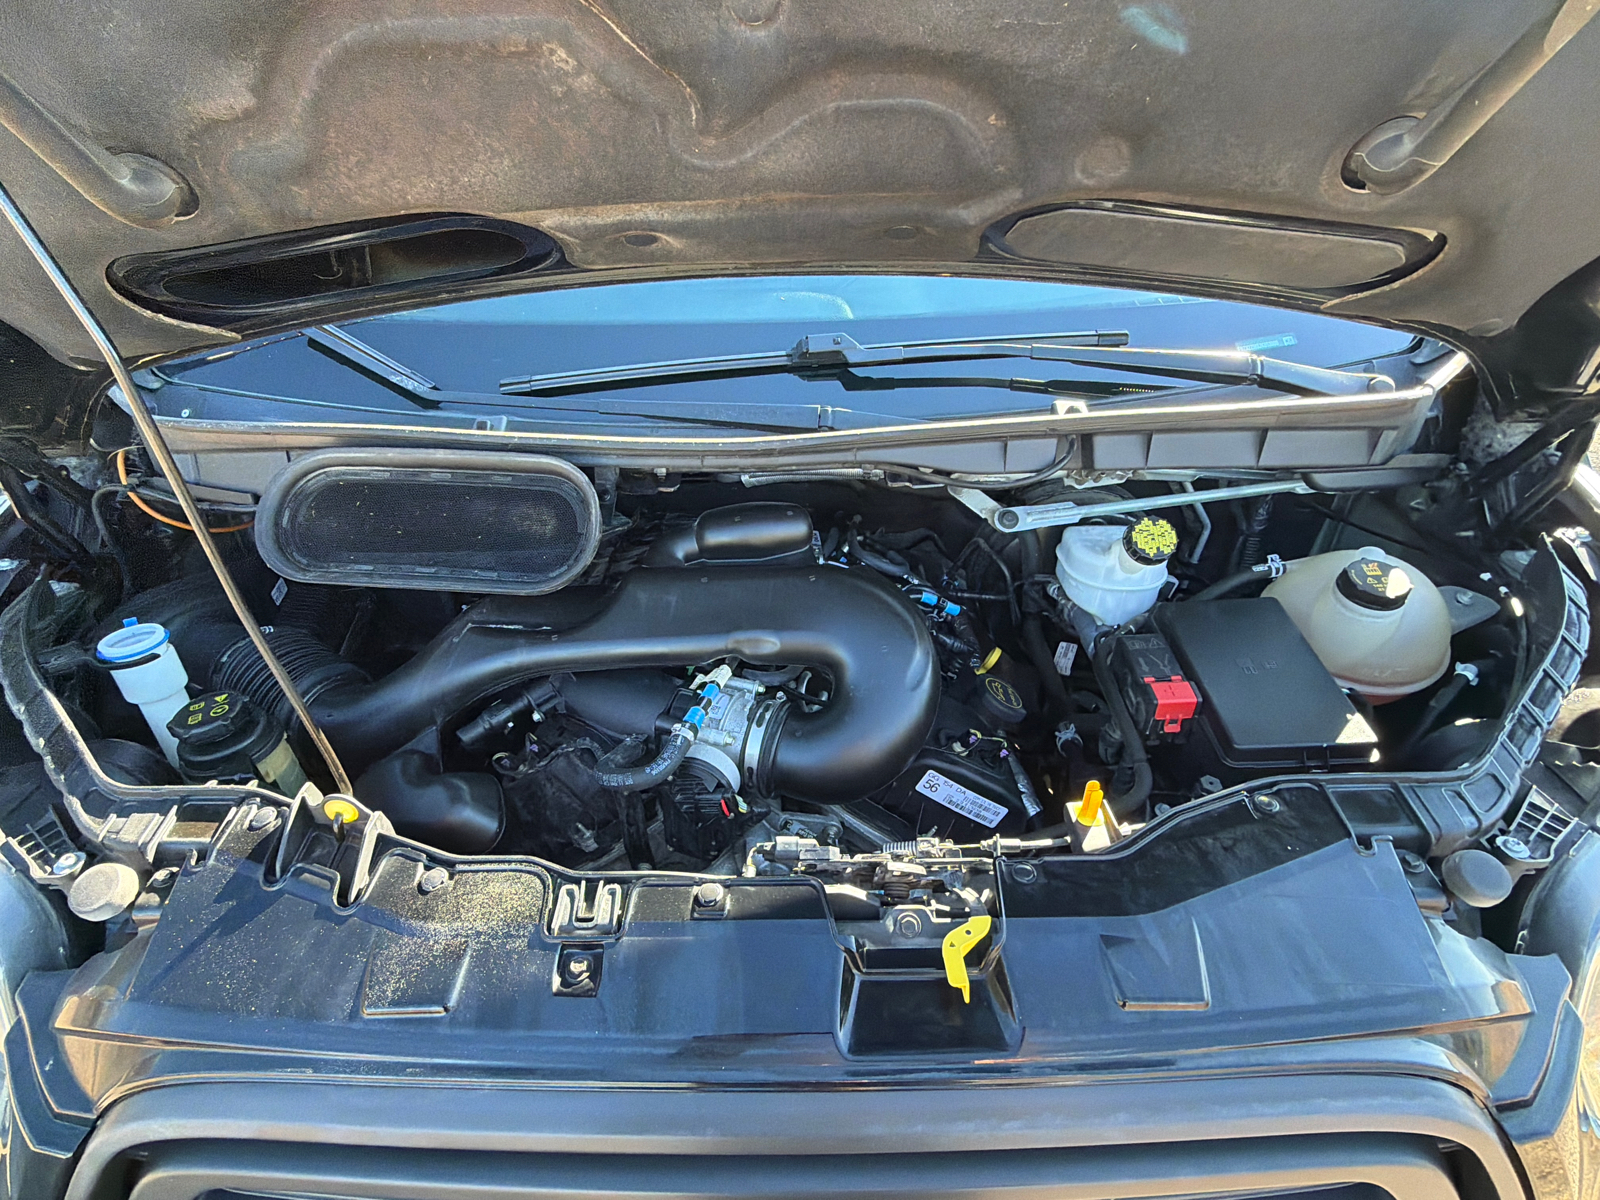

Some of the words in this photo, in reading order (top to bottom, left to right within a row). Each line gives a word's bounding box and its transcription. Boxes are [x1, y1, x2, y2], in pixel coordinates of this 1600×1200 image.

[922, 778, 941, 793] 56
[928, 772, 940, 782] GG
[955, 787, 967, 796] DA
